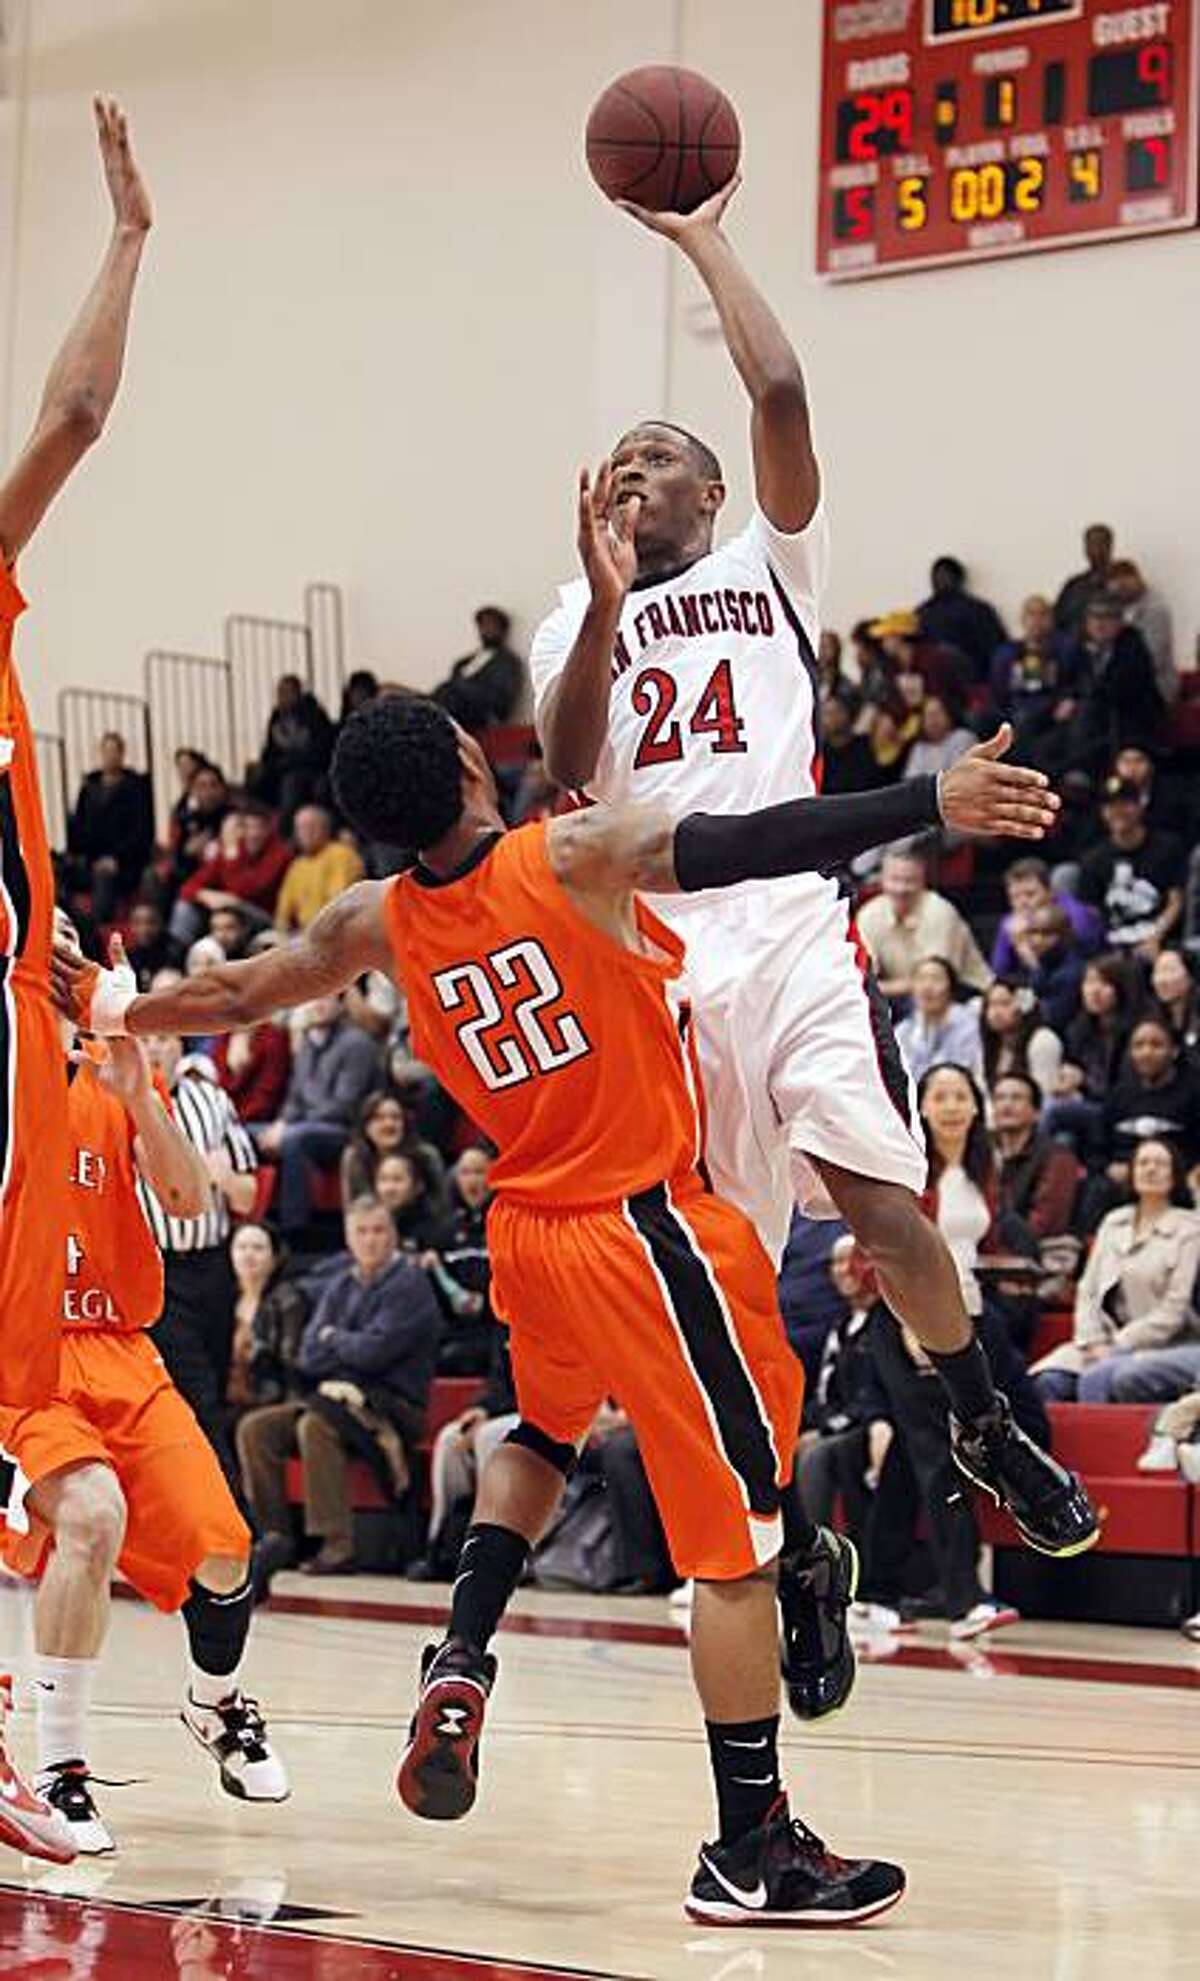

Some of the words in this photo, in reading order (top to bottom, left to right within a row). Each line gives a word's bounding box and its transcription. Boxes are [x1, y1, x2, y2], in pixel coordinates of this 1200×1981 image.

[1139, 46, 1168, 92] 9
[850, 90, 911, 159] 29
[901, 178, 926, 230] 5
[1071, 152, 1099, 196] 4
[633, 588, 775, 649] FRANCISCO
[631, 659, 748, 770] 24
[430, 936, 592, 1093] 22
